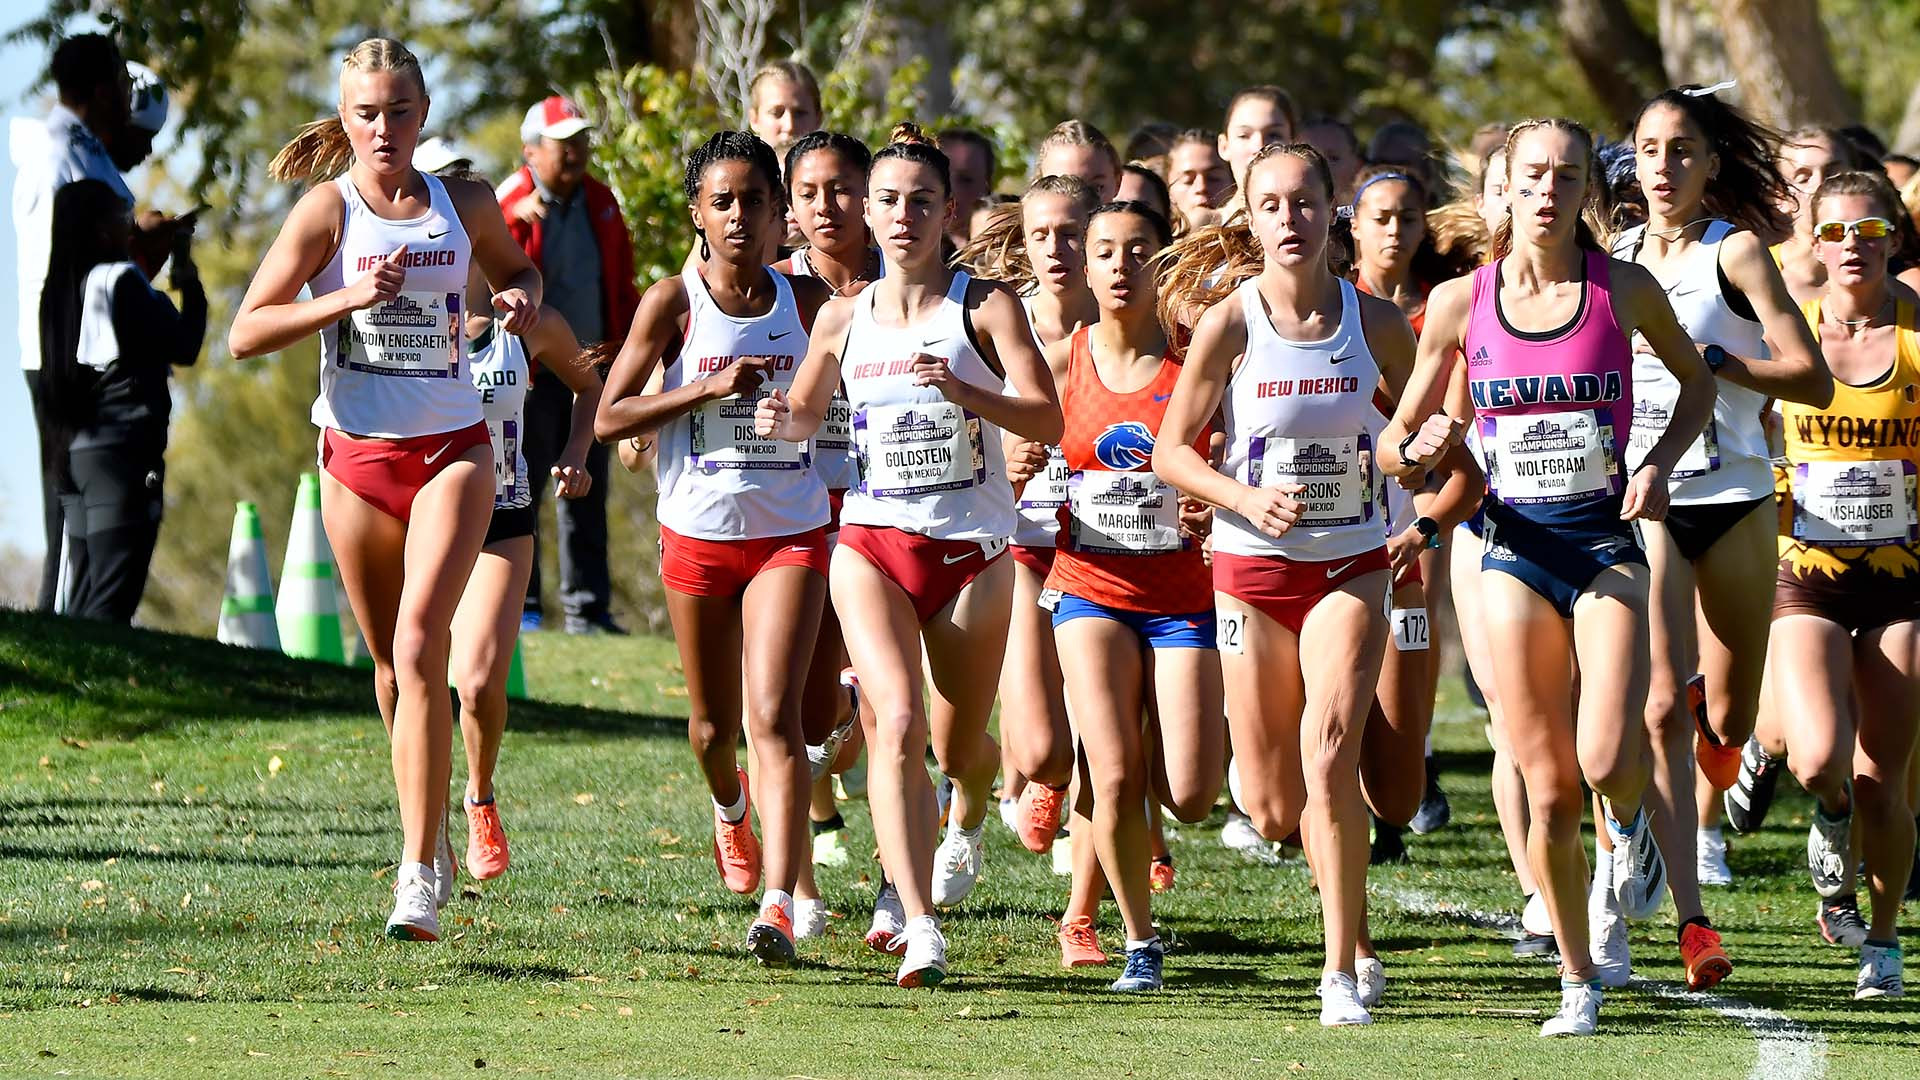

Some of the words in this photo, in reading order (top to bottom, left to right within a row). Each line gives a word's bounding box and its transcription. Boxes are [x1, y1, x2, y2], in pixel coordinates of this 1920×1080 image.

[357, 254, 391, 272] NE
[398, 250, 455, 268] MEXICO
[365, 314, 436, 325] CHAMPIONSHIPS
[352, 330, 385, 348] MODIN
[388, 334, 447, 349] ENGESAETH
[379, 352, 394, 361] NEW
[395, 352, 421, 362] MEXICO
[1470, 358, 1493, 367] adidas
[854, 362, 885, 380] NEW
[1257, 380, 1293, 398] NEW
[1298, 376, 1359, 396] MEXICO
[1470, 370, 1623, 409] NEVADA
[478, 388, 495, 404] E
[826, 425, 842, 434] NEW
[880, 427, 952, 443] CHAMPIONSHIPS
[1794, 415, 1920, 448] WYOMING
[735, 444, 750, 454] NEW
[751, 444, 777, 454] MEXICO
[1510, 436, 1585, 453] CHAMPIONSHIPS
[885, 446, 952, 467] GOLDSTEIN
[898, 470, 914, 480] NEW
[915, 467, 942, 478] MEXICO
[1277, 462, 1347, 474] CHAMPIONSHIPS
[1515, 456, 1586, 477] WOLFGRAM
[1049, 485, 1064, 494] NEW
[1286, 482, 1341, 499] ARSONS
[1537, 478, 1566, 489] NEVADA
[882, 488, 904, 496] OCTOBER
[1091, 495, 1162, 506] CHAMPIONSHIPS
[1309, 502, 1334, 512] MEXICO
[1098, 513, 1156, 530] MARGHINI
[1126, 533, 1147, 542] STATE
[1489, 551, 1517, 562] adidas
[1399, 614, 1427, 643] 172
